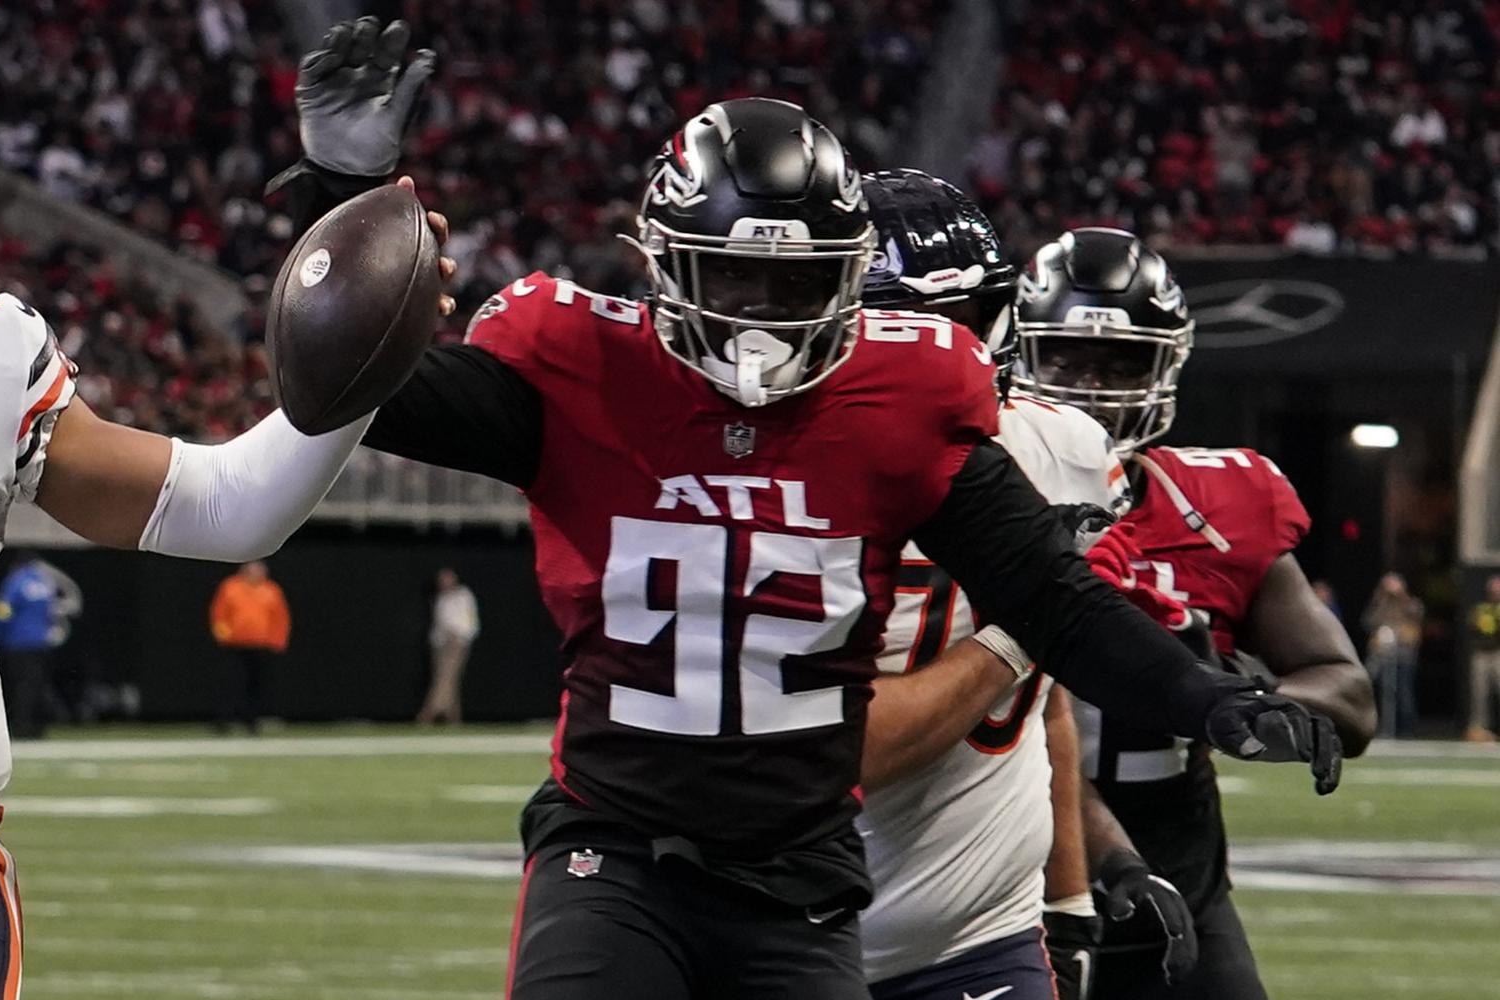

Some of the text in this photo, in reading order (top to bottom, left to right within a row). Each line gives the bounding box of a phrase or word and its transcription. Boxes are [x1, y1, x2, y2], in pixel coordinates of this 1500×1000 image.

[752, 225, 791, 238] ATL
[654, 474, 831, 530] ATL
[602, 516, 868, 737] 92
